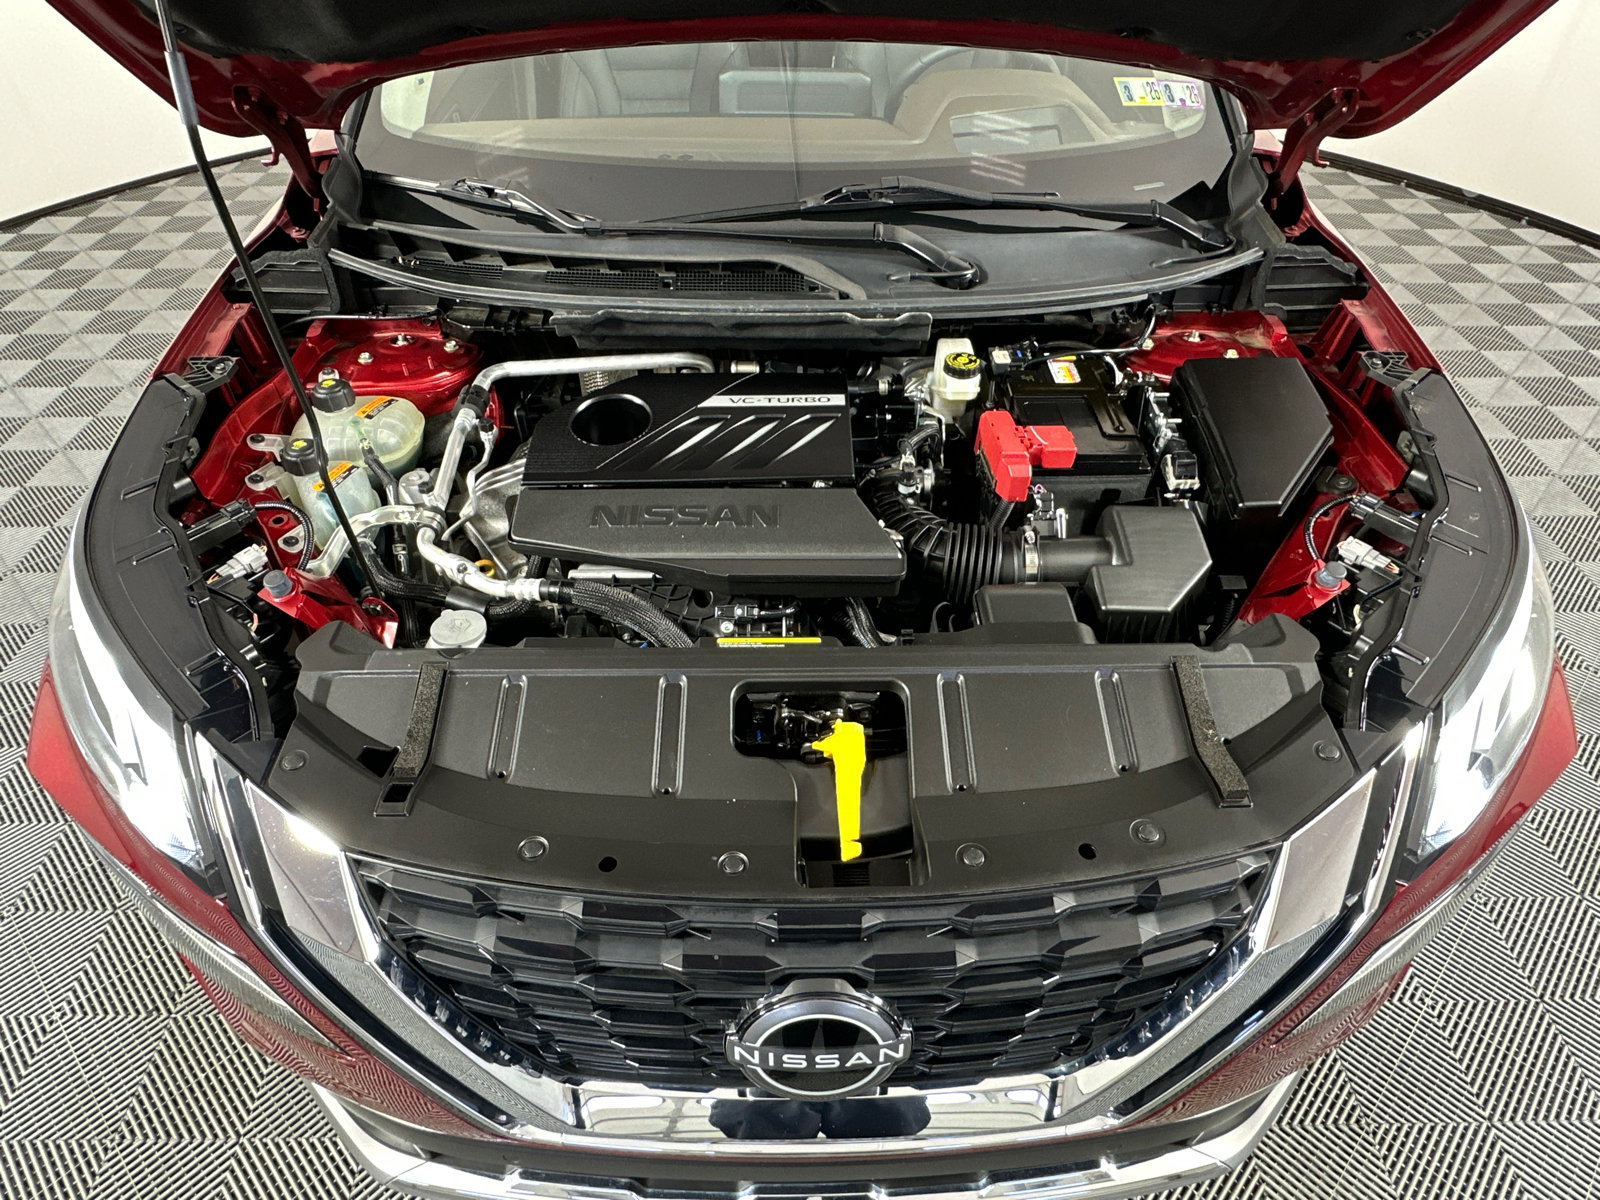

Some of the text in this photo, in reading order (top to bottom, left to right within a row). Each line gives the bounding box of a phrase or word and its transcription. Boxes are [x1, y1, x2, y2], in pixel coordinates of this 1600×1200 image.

[1123, 84, 1134, 102] 3
[1164, 83, 1175, 103] 3
[589, 504, 780, 528] NISSAN
[733, 1043, 905, 1070] NISSAN
